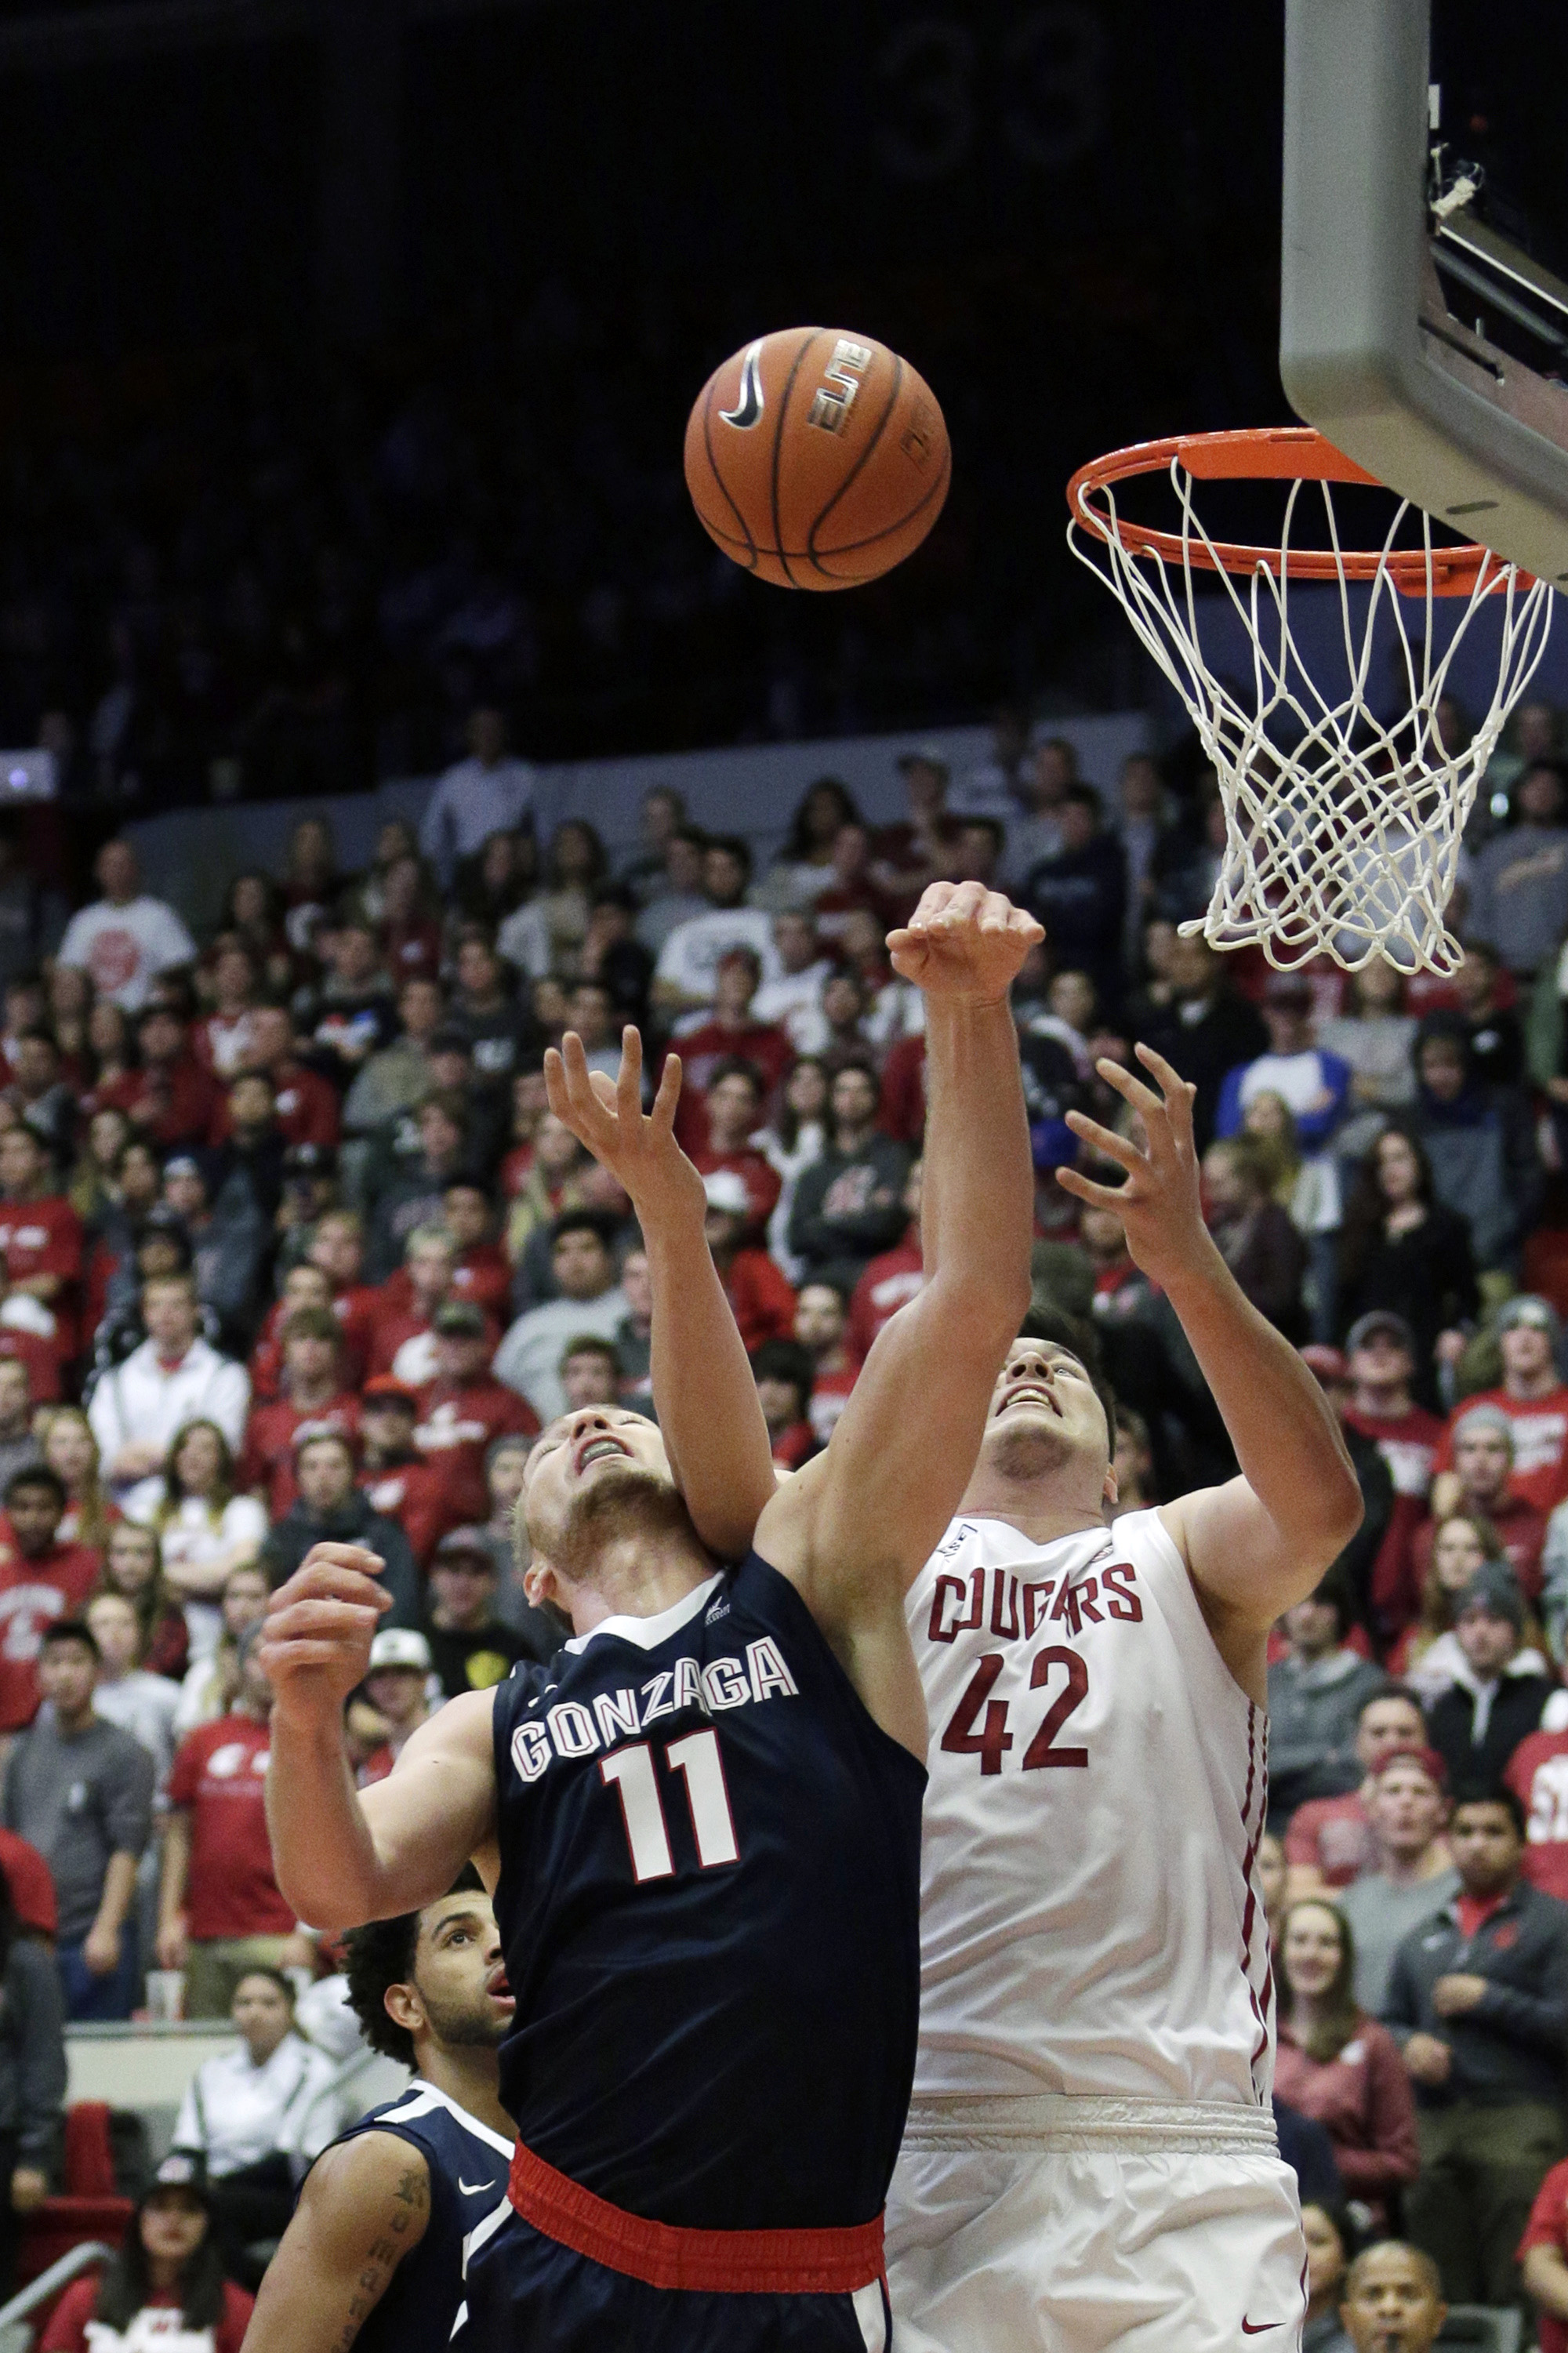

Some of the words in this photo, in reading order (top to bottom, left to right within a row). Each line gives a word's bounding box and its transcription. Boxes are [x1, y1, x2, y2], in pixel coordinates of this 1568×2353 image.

[928, 1563, 1143, 1643] COUGARS
[511, 1636, 799, 1782] GONZAGA
[941, 1645, 1089, 1775] 42
[597, 1727, 741, 1884] 11
